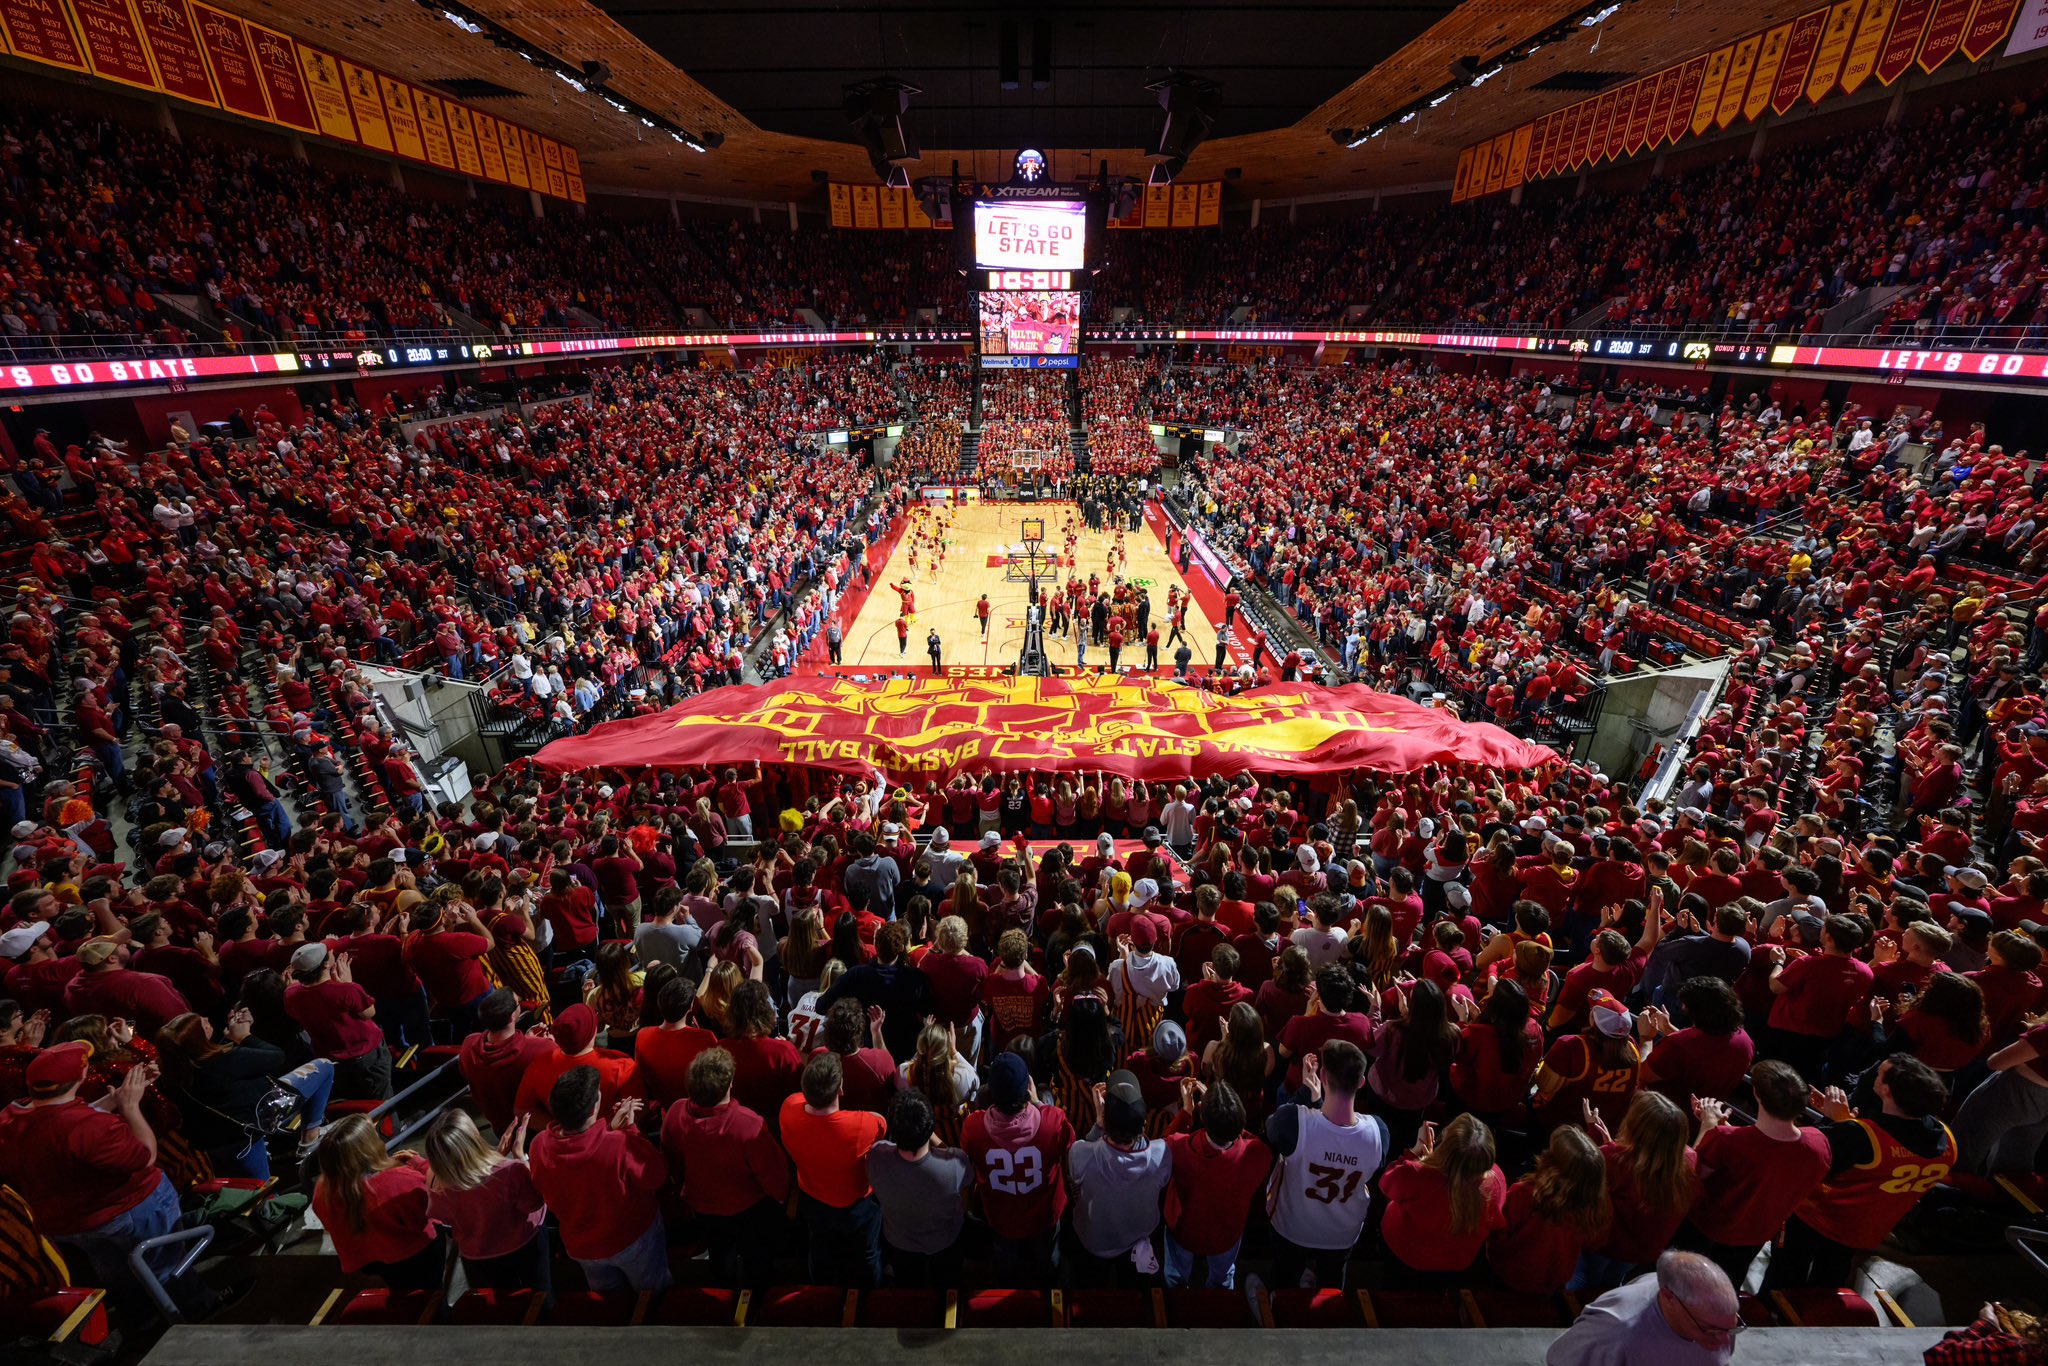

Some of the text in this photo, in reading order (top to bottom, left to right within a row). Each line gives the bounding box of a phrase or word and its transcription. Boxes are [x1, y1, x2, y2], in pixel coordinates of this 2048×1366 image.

[8, 8, 30, 20] 1996
[141, 0, 185, 28] STATE
[1936, 11, 1966, 24] NATIONAL
[10, 19, 36, 32] 2000
[41, 17, 61, 29] 1997
[85, 13, 131, 38] NCAA
[1973, 20, 2002, 37] 1994
[46, 28, 66, 40] 2001
[205, 23, 242, 47] STATE
[151, 36, 198, 59] SWEET 16
[259, 42, 292, 65] STATE
[55, 51, 75, 62] 2014
[99, 53, 119, 65] 2022
[221, 56, 243, 69] ELITE
[1886, 48, 1911, 64] 1987
[126, 61, 147, 73] 2023
[223, 65, 246, 77] EIGHT
[1847, 62, 1867, 75] 1981
[273, 73, 293, 85] FINAL
[1812, 73, 1833, 86] 1978
[274, 80, 296, 92] FOUR
[1778, 83, 1799, 97] 1977
[1750, 93, 1767, 104] 1977
[391, 114, 415, 129] WNIT
[1696, 111, 1712, 121] 1975
[425, 126, 444, 139] NCAA
[552, 174, 563, 188] 53
[570, 180, 581, 192] 32
[995, 186, 1060, 197] XTREAM
[988, 220, 1073, 240] LET'S GO
[999, 237, 1059, 256] STATE
[996, 272, 1063, 290] I-S-U
[634, 335, 728, 347] LET'S GO STATE
[759, 333, 837, 342] LET'S GO STATE
[1010, 329, 1044, 341] HILTON
[1215, 331, 1294, 340] LET'S GO STATE
[1325, 332, 1420, 343] LET'S GO STATE
[1437, 335, 1498, 348] LET'S GO STATE
[461, 345, 469, 358] 0
[560, 339, 618, 352] LET'S GO STATE
[1010, 341, 1039, 351] MAGIC
[1593, 340, 1602, 352] 0
[1608, 341, 1652, 354] 20:00 1ST
[1668, 342, 1678, 356] 0
[1738, 345, 1751, 353] FLS
[299, 353, 312, 361] TOL
[332, 352, 353, 360] BONUS
[357, 353, 384, 366] STATE
[388, 349, 398, 362] 0
[406, 348, 448, 362] 20:00 1ST
[1739, 352, 1746, 360] 0
[322, 360, 329, 368] 0
[1048, 358, 1069, 367] pepsi
[1878, 350, 2025, 376] LET'S GO
[50, 363, 94, 384] GO
[109, 358, 198, 381] STATE
[1889, 376, 1904, 384] 113
[172, 384, 185, 392] 131
[1094, 738, 1201, 757] STATE
[779, 739, 981, 772] BASKETBALL
[1008, 801, 1022, 810] 23
[1592, 1065, 1631, 1093] 22
[1324, 1151, 1358, 1166] NIANG
[985, 1146, 1043, 1195] 23
[1305, 1163, 1363, 1204] 31
[1879, 1163, 1950, 1194] 22
